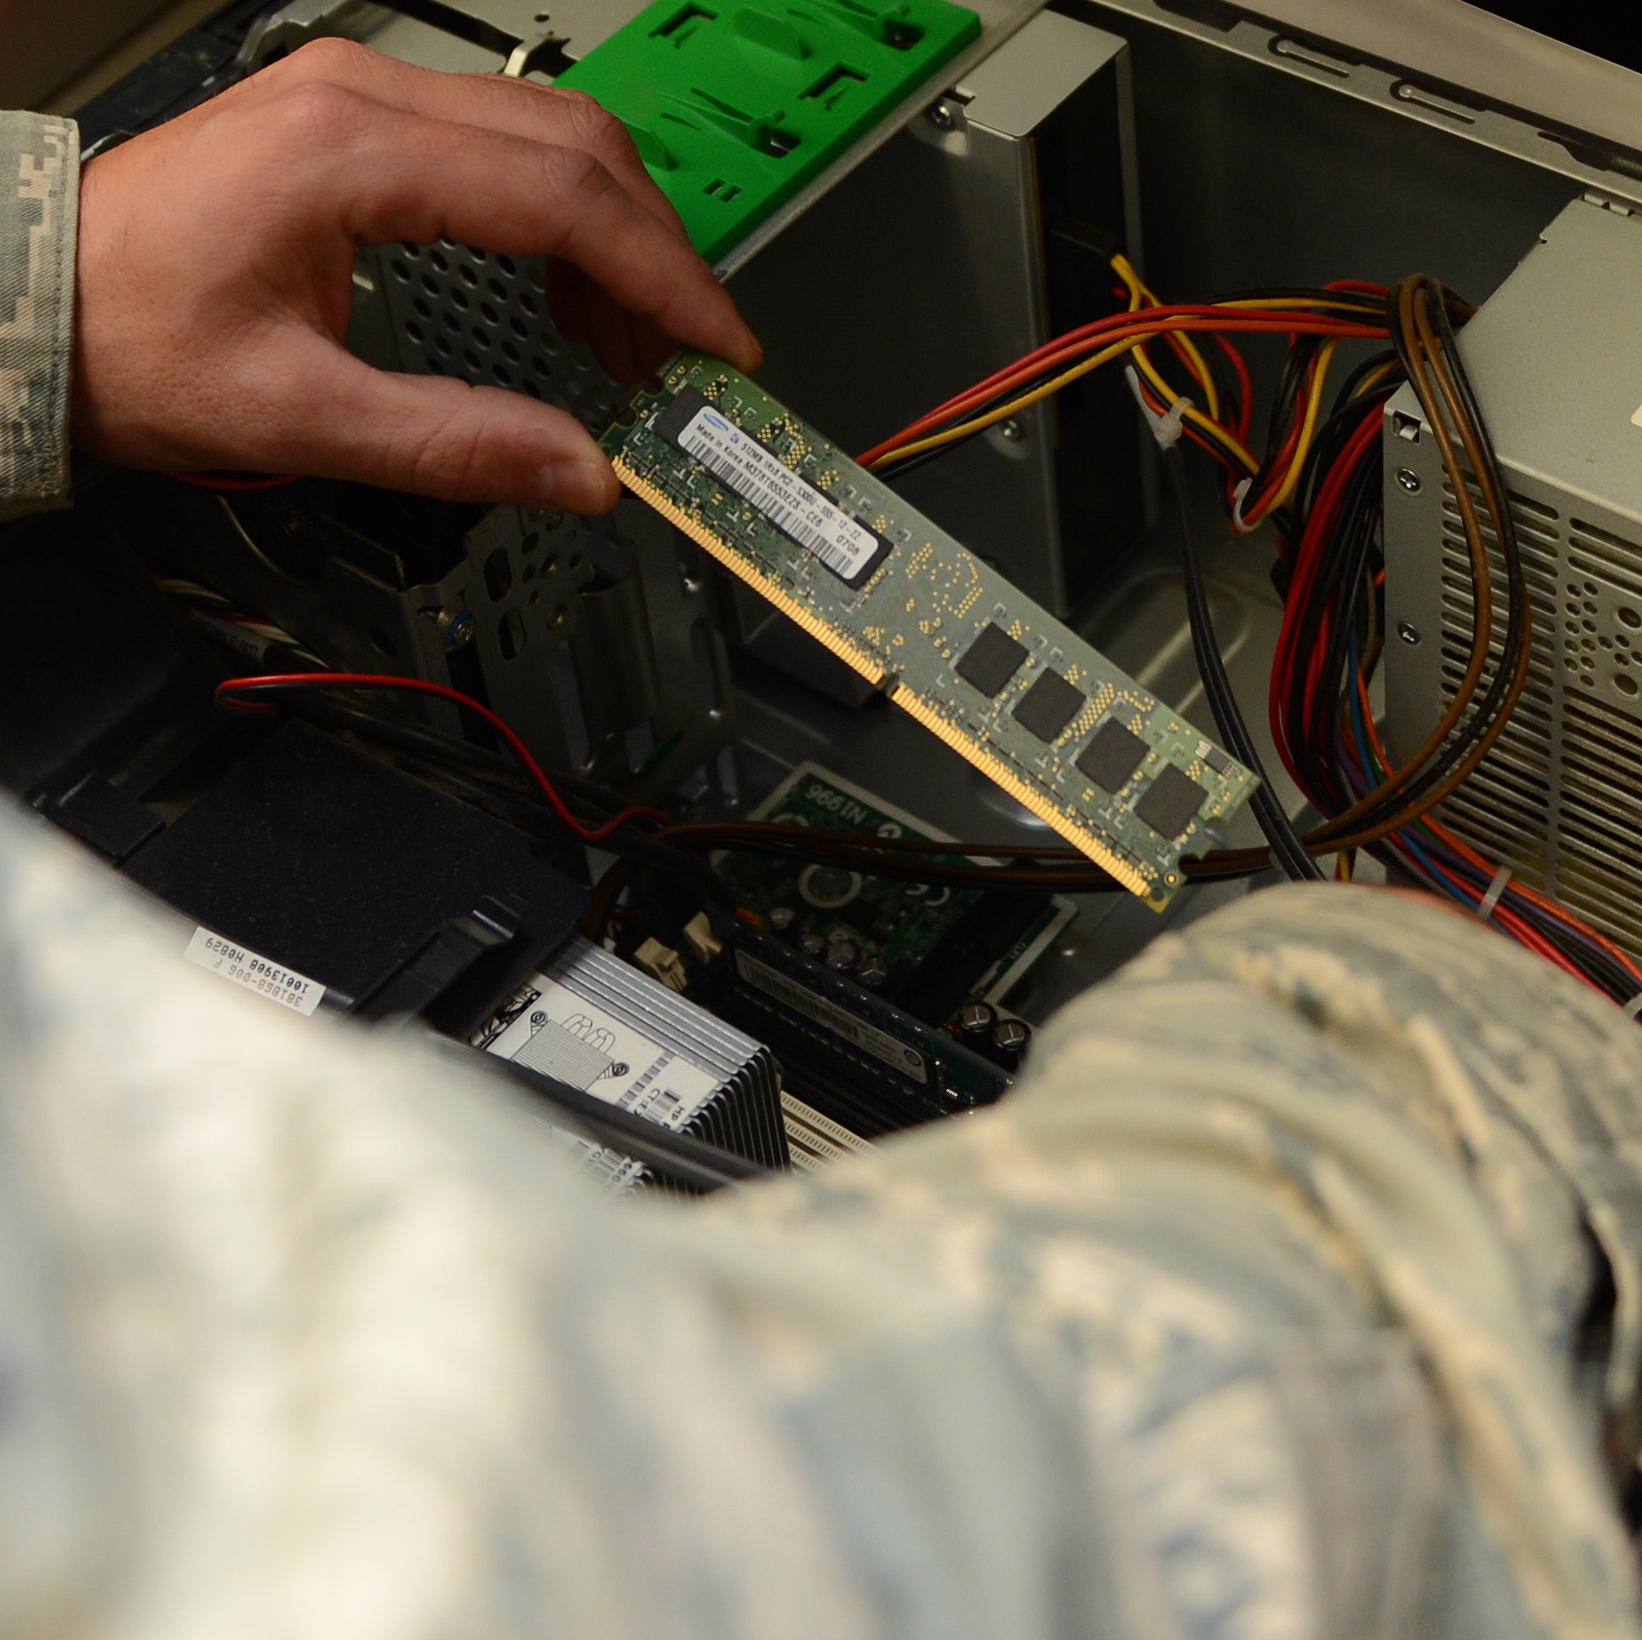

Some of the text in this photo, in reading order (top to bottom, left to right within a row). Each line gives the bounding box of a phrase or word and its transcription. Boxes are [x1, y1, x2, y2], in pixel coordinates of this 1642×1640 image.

[694, 423, 716, 442] Made
[713, 438, 724, 448] in
[722, 445, 744, 465] Korea
